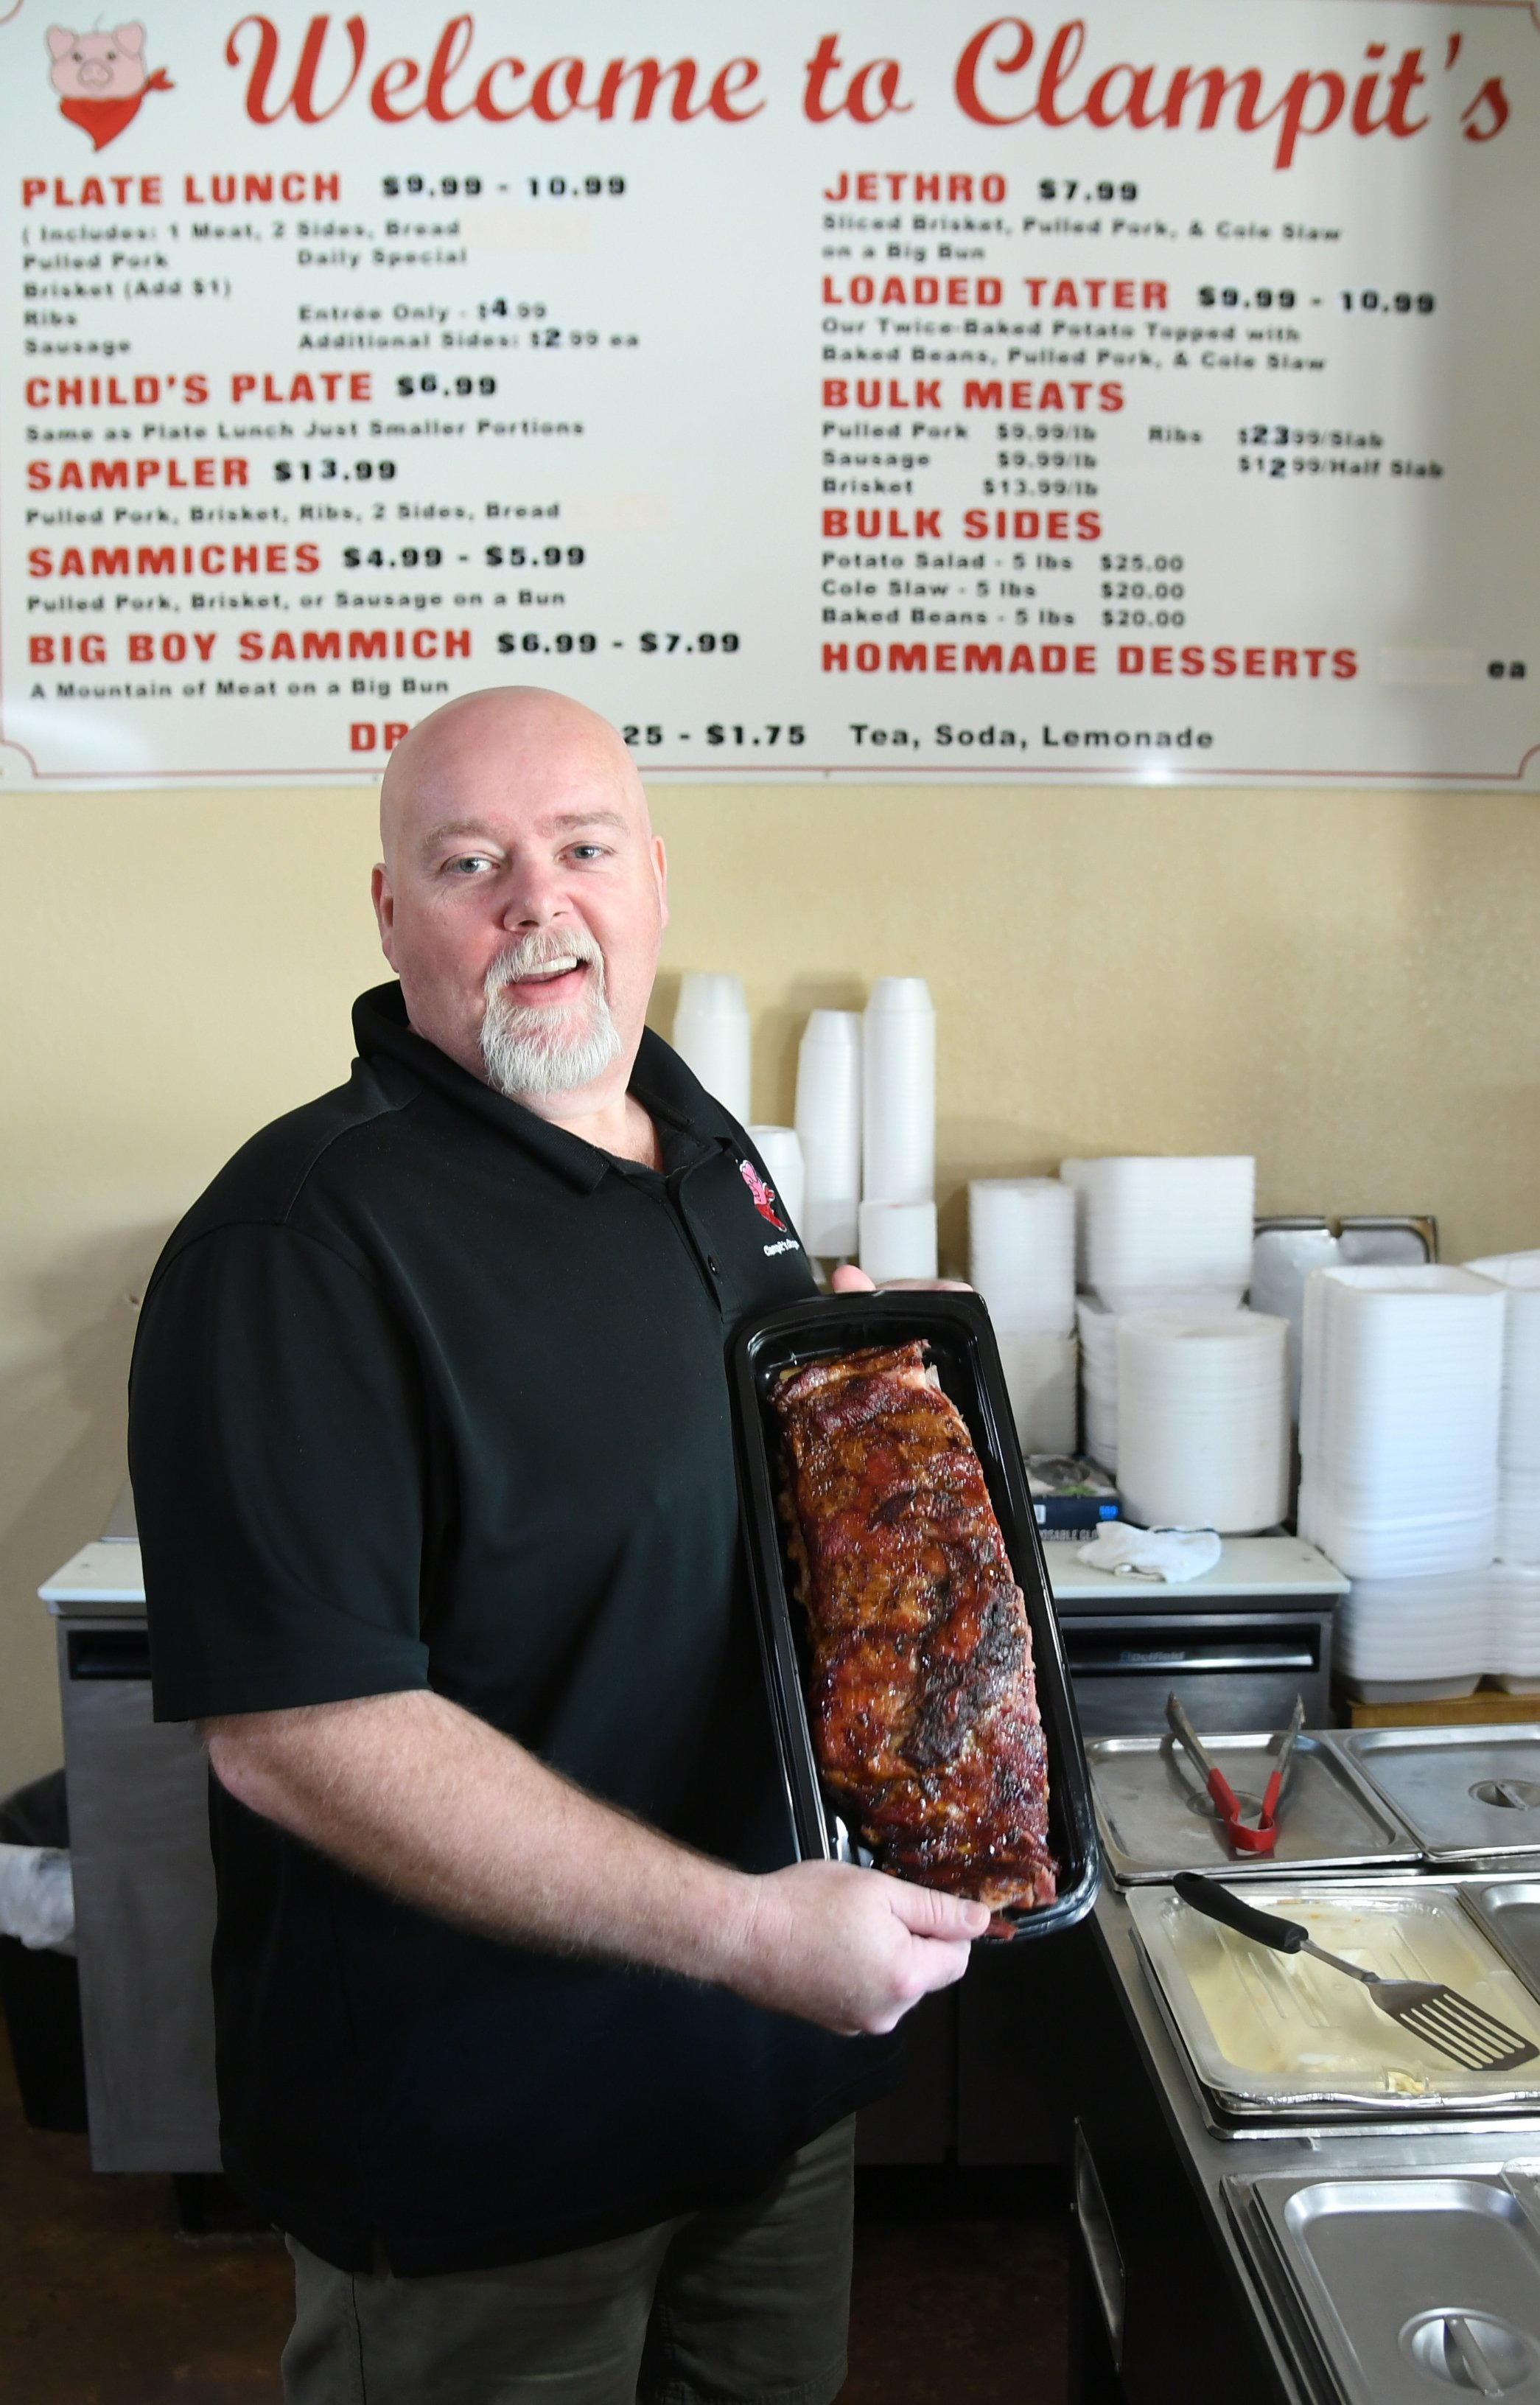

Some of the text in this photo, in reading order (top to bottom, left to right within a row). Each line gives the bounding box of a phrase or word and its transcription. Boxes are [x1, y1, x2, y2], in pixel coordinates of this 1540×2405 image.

[225, 14, 1508, 170] Welcome to Clampit's
[22, 175, 161, 207] PLATE
[185, 172, 339, 204] LUNCH
[382, 175, 482, 198] $9.99
[530, 175, 626, 197] 10.99
[824, 172, 1138, 203] JETHRO $7.99
[169, 224, 178, 239] 1
[273, 221, 284, 239] 2
[385, 220, 460, 237] Bread
[823, 213, 902, 231] Sliced
[1023, 216, 1102, 234] Pulled
[1189, 220, 1204, 237] &
[1216, 221, 1270, 239] Cole
[1283, 223, 1341, 241] Slaw
[23, 252, 168, 270] Pulled Pork
[298, 248, 466, 269] Daily Special
[822, 242, 985, 263] on a Big Bun
[23, 279, 231, 299] Brisket (Add $1)
[822, 275, 1002, 307] LOADED
[1024, 278, 1167, 310] TATER
[1198, 285, 1296, 310] $9.99
[1343, 290, 1434, 315] 10.99
[24, 310, 77, 327] Ribs
[393, 304, 449, 324] Only
[299, 333, 430, 349] Additional
[610, 335, 639, 347] ea
[822, 317, 864, 334] Our
[1052, 319, 1135, 338] Potato
[1147, 321, 1236, 343] Topped
[1247, 328, 1300, 341] with
[25, 338, 130, 357] Sausage
[822, 345, 900, 363] Baked
[1008, 346, 1086, 366] Pulled
[1174, 351, 1189, 367] &
[1201, 351, 1256, 369] Cole
[1267, 353, 1325, 371] Slaw
[25, 372, 497, 408] CHILD'S PLATE $6.99
[822, 378, 1124, 412] BULK MEATS
[26, 419, 584, 443] Same as Plate Lunch Just Smaller Portions
[822, 421, 901, 439] Pulled
[911, 422, 967, 439] Pork
[1149, 425, 1202, 443] Ribs
[823, 449, 929, 470] Sausage
[27, 458, 396, 491] SAMPLER $13.99
[822, 477, 912, 494] Brisket
[26, 509, 103, 525] Pulled
[374, 503, 385, 520] 2
[486, 502, 559, 519] Bread
[822, 508, 1102, 541] BULK SIDES
[28, 542, 320, 578] SAMMICHES
[343, 547, 442, 568] $4.99
[486, 545, 585, 567] $5.99
[822, 551, 904, 568] Potato
[916, 551, 985, 569] Salad
[1013, 553, 1026, 569] 5
[1037, 554, 1072, 570] lbs
[1100, 554, 1183, 572] $25.00
[27, 596, 105, 612] Pulled
[300, 596, 323, 608] or
[336, 591, 442, 611] Sausage
[454, 593, 483, 606] on
[494, 594, 507, 605] a
[518, 589, 564, 606] Bun
[822, 579, 877, 596] Cole
[889, 579, 948, 596] Slaw
[977, 580, 989, 597] 5
[1000, 582, 1036, 598] lbs
[1101, 581, 1185, 600] $20.00
[822, 607, 900, 624] Baked
[911, 607, 987, 625] Beans
[1015, 608, 1028, 625] 5
[1039, 610, 1074, 625] lbs
[1102, 609, 1186, 628] $20.00
[29, 634, 106, 664] BIG
[128, 632, 216, 663] BOY
[239, 629, 471, 662] SAMMICH
[497, 632, 597, 654] $6.99
[640, 632, 739, 653] $7.99
[822, 642, 1526, 680] HOMEMADE DESSERTS ea
[31, 677, 448, 699] A Mountain of Meat on a Big Bun
[351, 722, 409, 751] DR
[623, 725, 662, 745] 25
[707, 723, 805, 745] $1.75
[850, 724, 920, 749] Tea,
[935, 724, 1027, 750] Soda,
[1043, 725, 1213, 748] Lemonade
[1079, 1529, 1099, 1540] GLO
